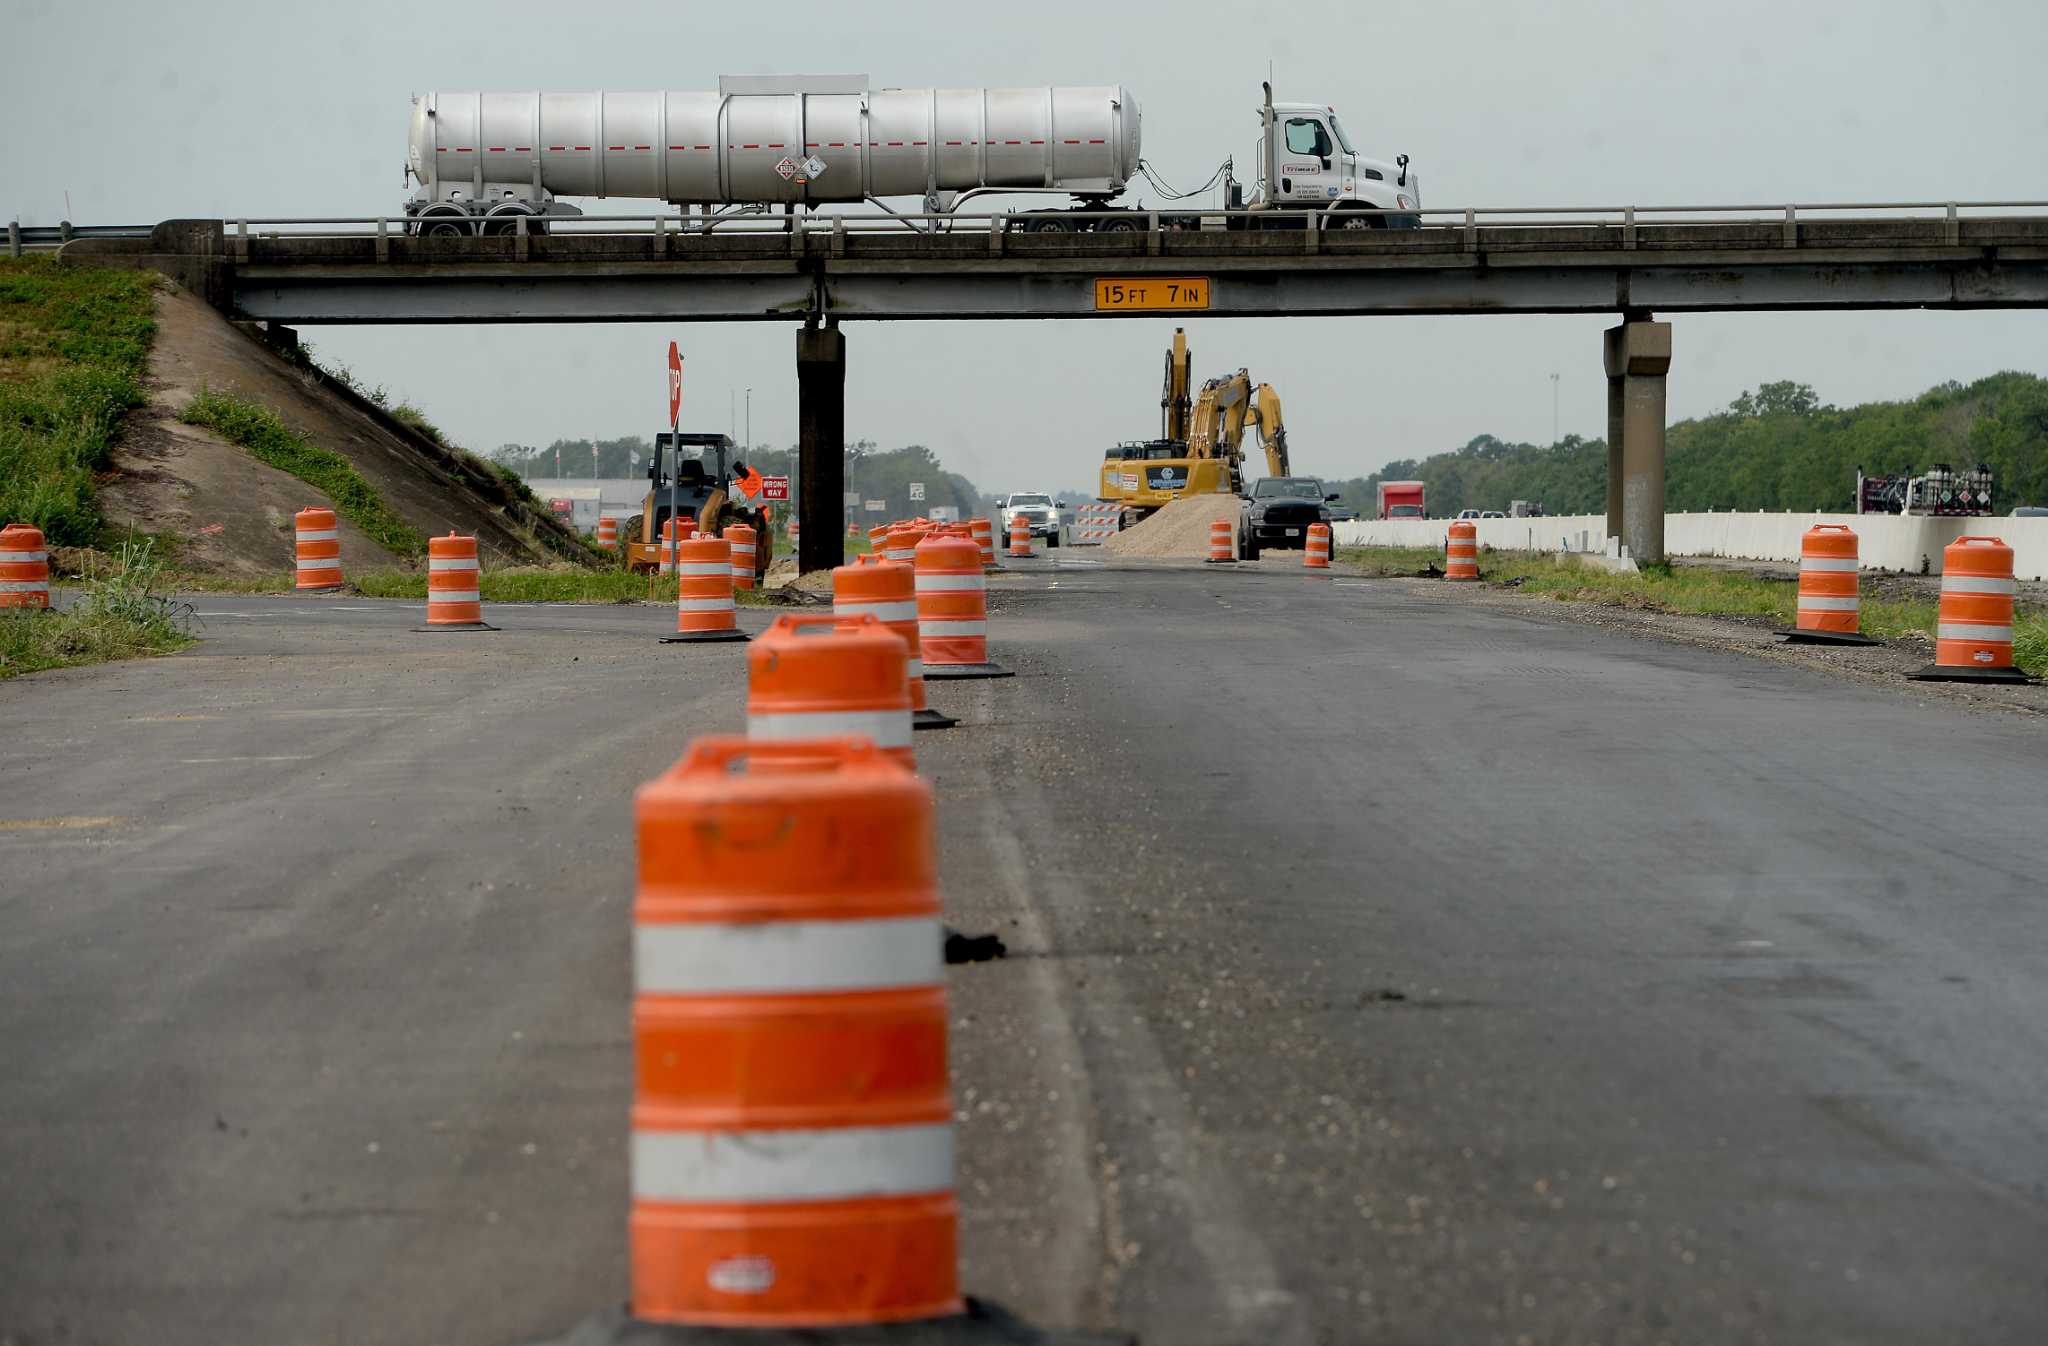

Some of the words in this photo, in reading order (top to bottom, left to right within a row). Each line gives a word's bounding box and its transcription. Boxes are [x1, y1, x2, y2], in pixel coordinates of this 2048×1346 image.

[1104, 286, 1124, 303] 15
[1129, 289, 1147, 303] FT
[1167, 285, 1179, 303] 7
[1184, 288, 1198, 303] IN
[763, 480, 787, 488] WRONG
